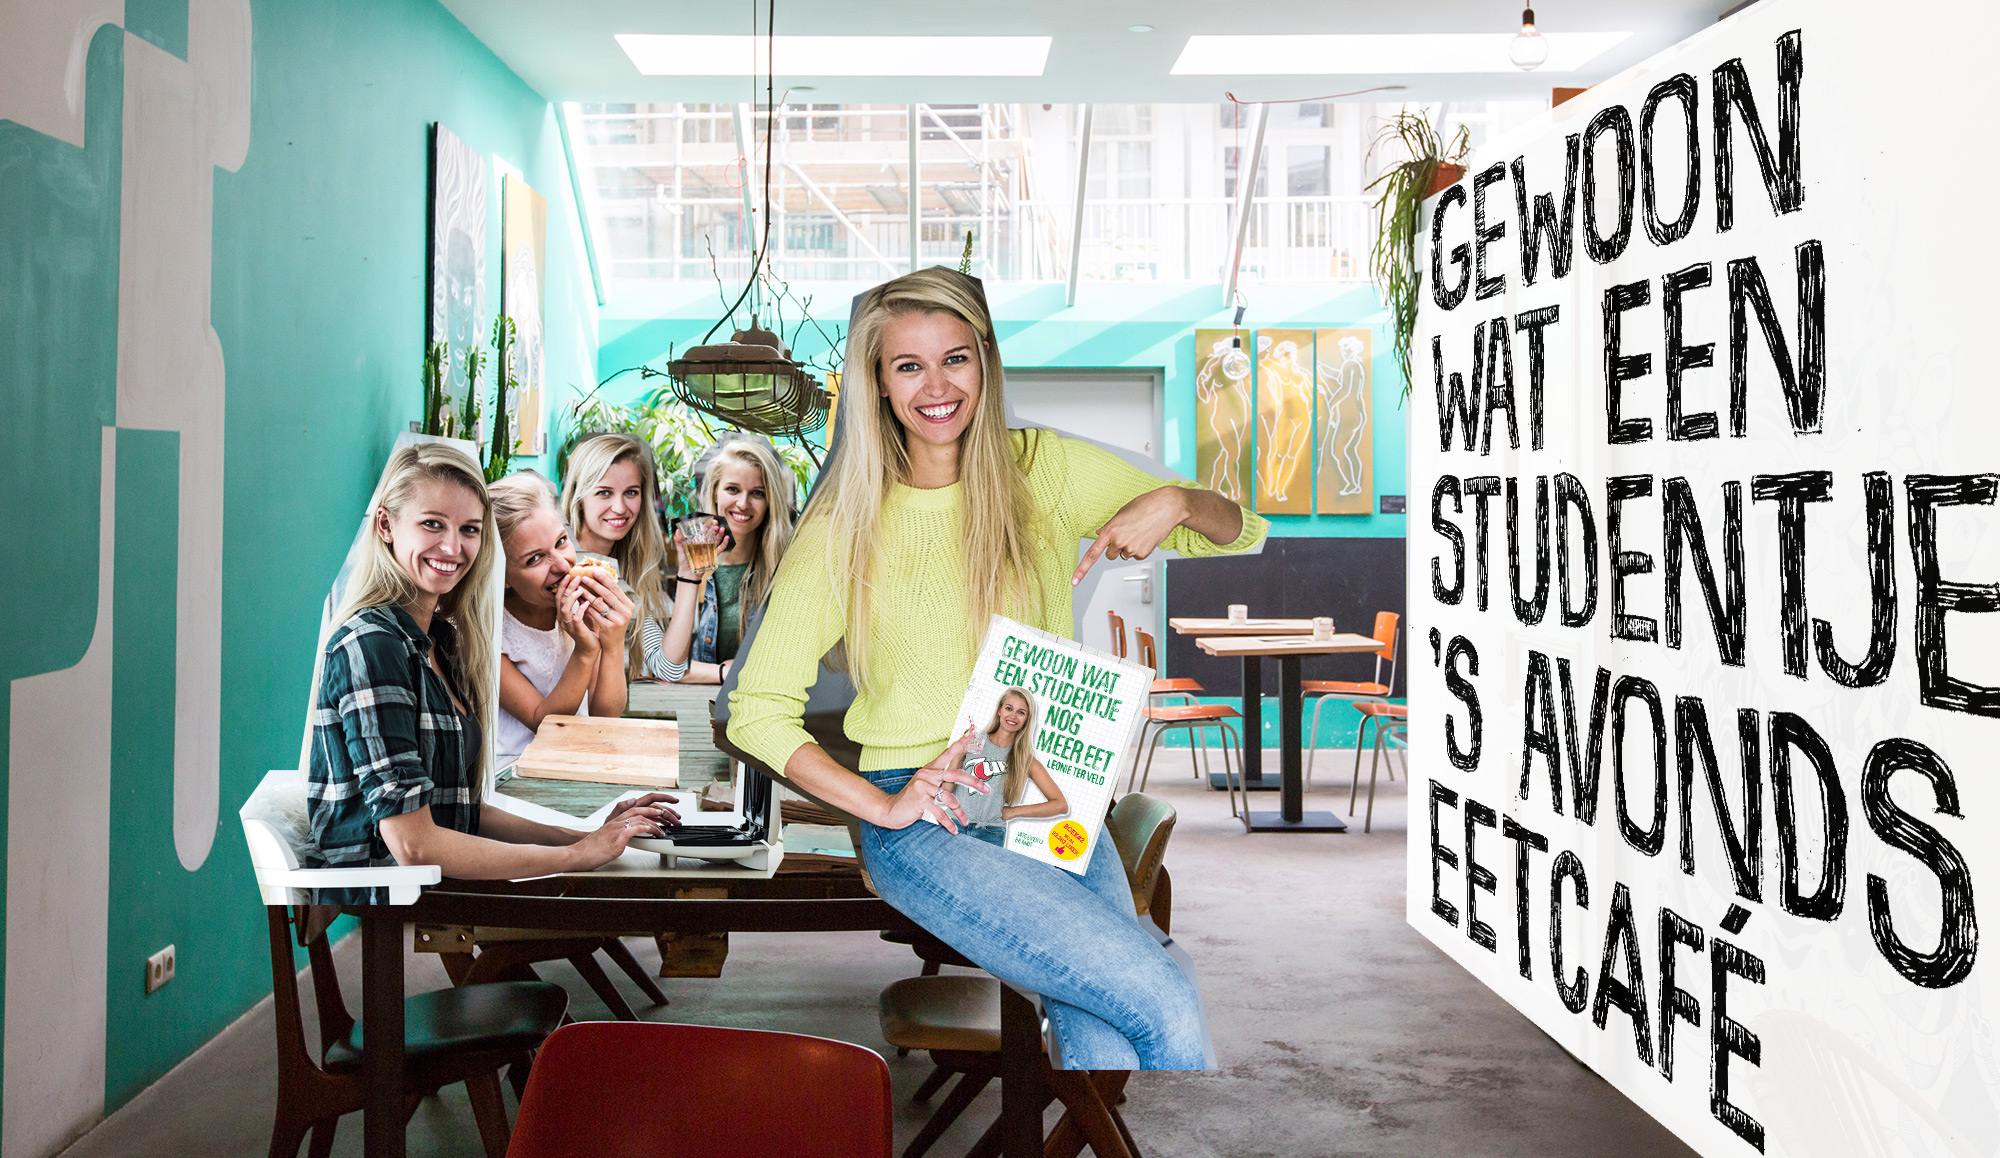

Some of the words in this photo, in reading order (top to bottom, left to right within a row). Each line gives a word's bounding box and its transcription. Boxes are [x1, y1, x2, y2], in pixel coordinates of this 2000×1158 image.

[1431, 29, 1805, 311] GEWOON
[1431, 304, 1560, 456] WAT
[1601, 239, 1826, 445] EEN
[1431, 470, 2000, 718] STUDENTJE
[993, 659, 1028, 687] EEN
[1028, 672, 1123, 722] STUDENTJE
[1002, 635, 1078, 680] GEWOON
[1080, 662, 1121, 694] WAT
[1044, 704, 1083, 736] NOG
[1036, 728, 1085, 764] MEER
[1084, 744, 1115, 773] EET
[1046, 758, 1072, 775] LEONIE
[1073, 765, 1086, 779] TER
[1086, 769, 1105, 786] VELD
[1518, 649, 1979, 989] AVONDS
[1428, 779, 1766, 1155] EETCAFÉ
